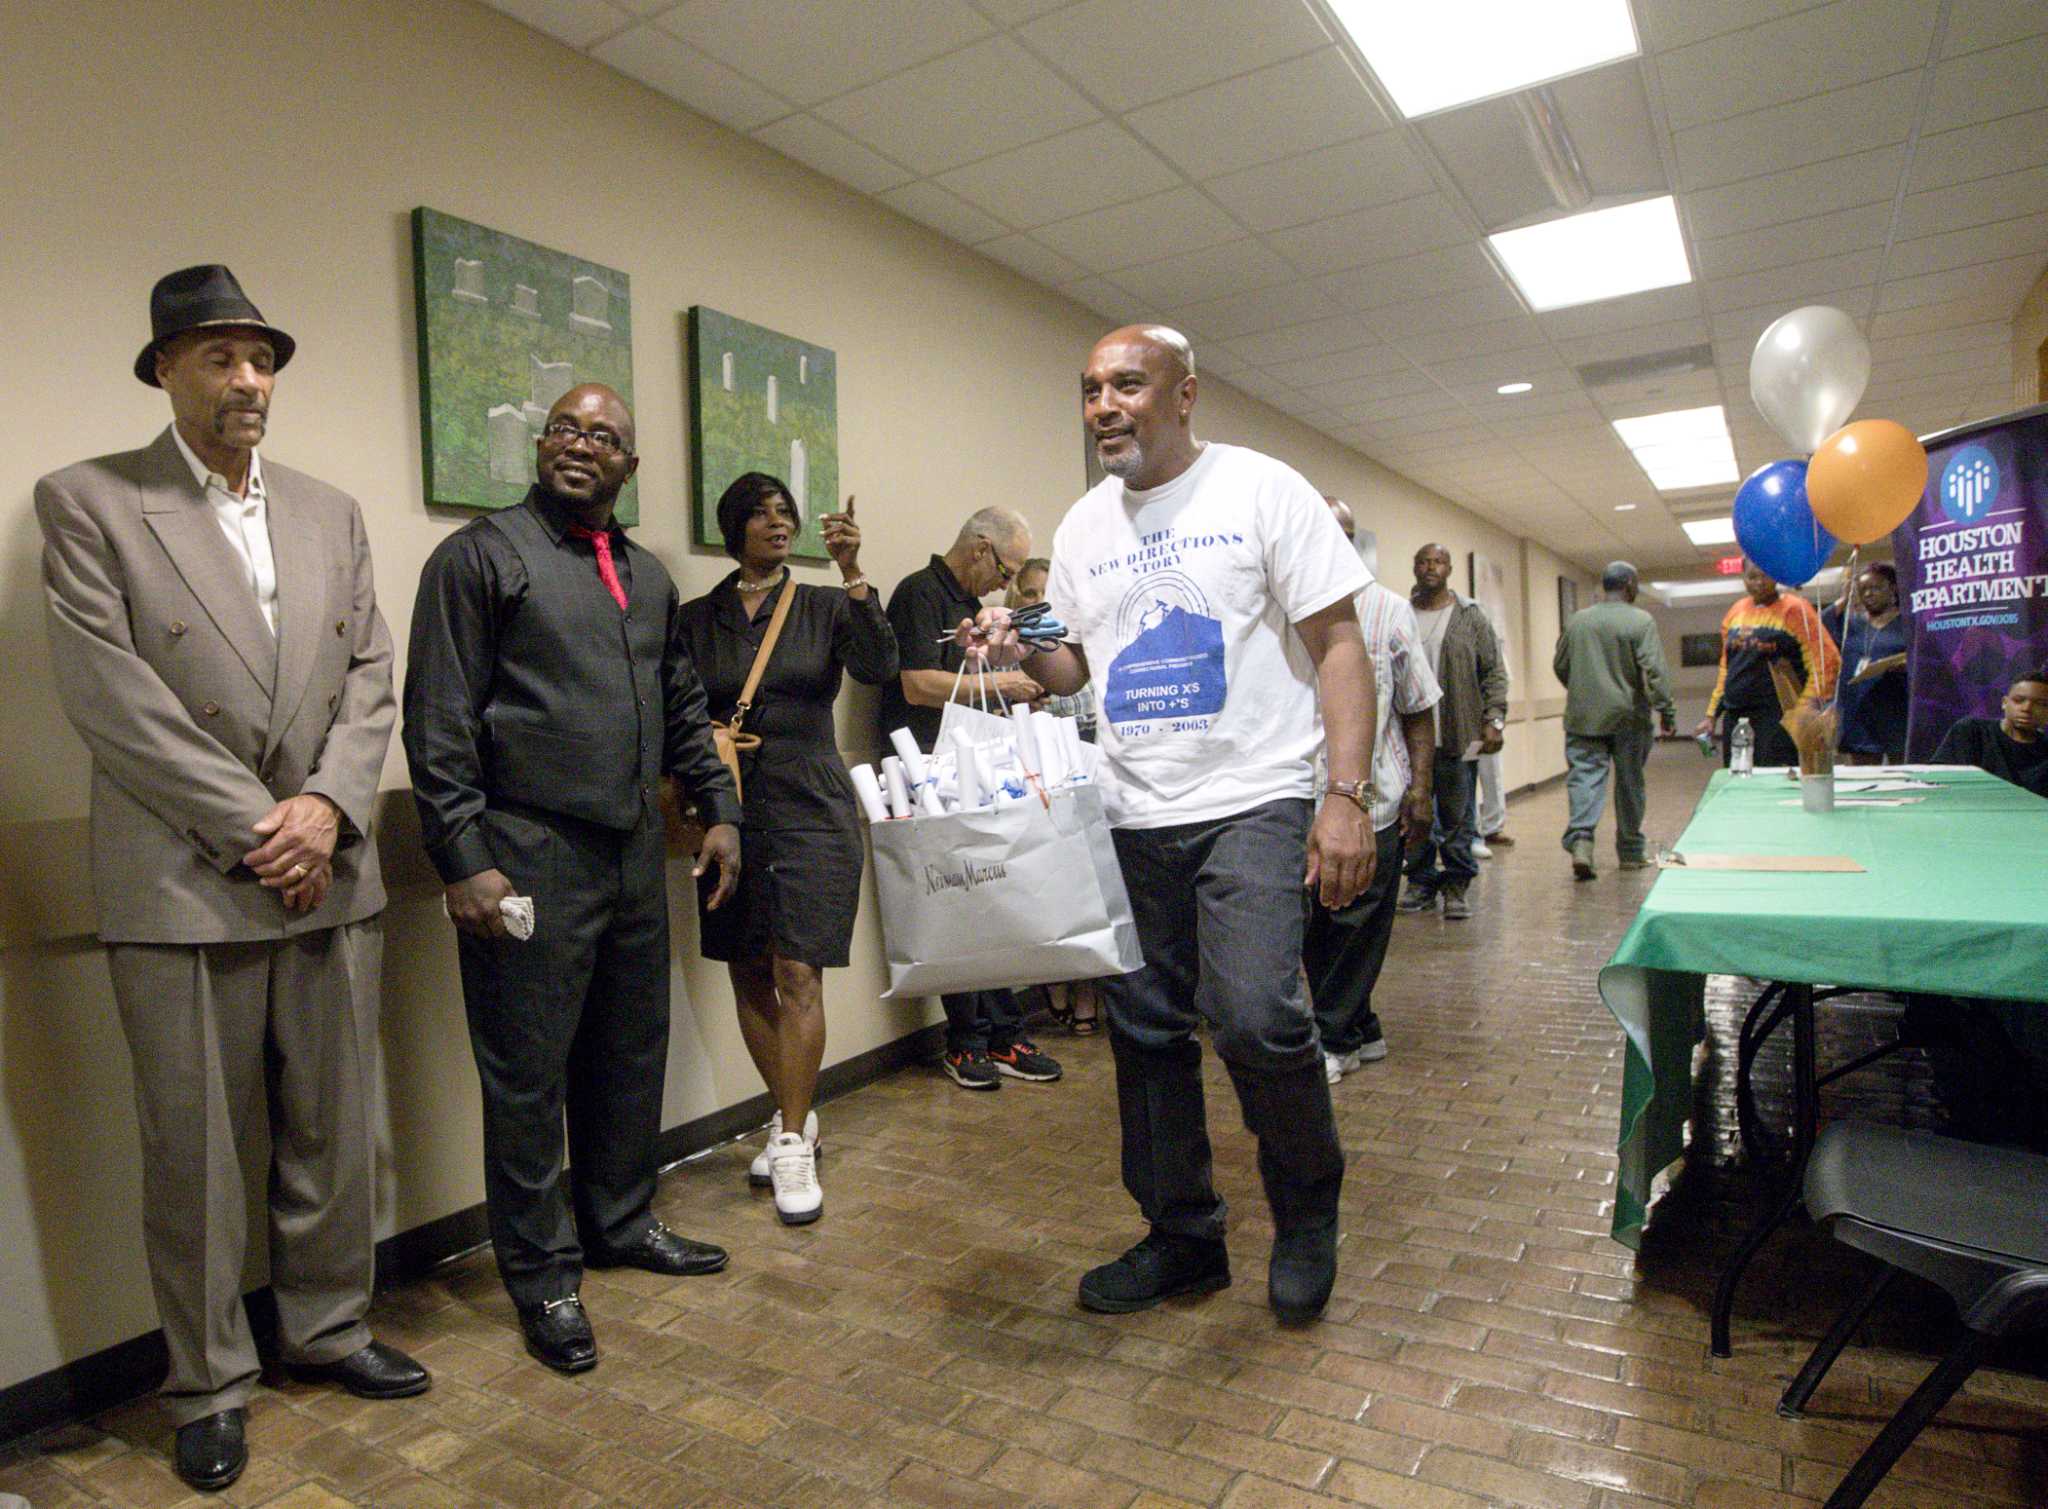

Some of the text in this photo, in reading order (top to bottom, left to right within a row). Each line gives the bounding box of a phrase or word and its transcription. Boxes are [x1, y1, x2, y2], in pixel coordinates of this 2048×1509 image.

[1140, 528, 1175, 546] THE
[1919, 521, 2024, 561] HOUSTON
[1089, 533, 1244, 577] NEW DIRECTIONS
[1132, 554, 1182, 575] STORY
[1925, 550, 2016, 584] HEALTH
[1910, 574, 2048, 613] EPARTMENT
[1125, 684, 1179, 700] TURNING
[1137, 700, 1166, 713] INTO
[1120, 723, 1151, 737] 1970
[1171, 719, 1209, 733] 2003
[923, 859, 1007, 896] Neiman Marcus
